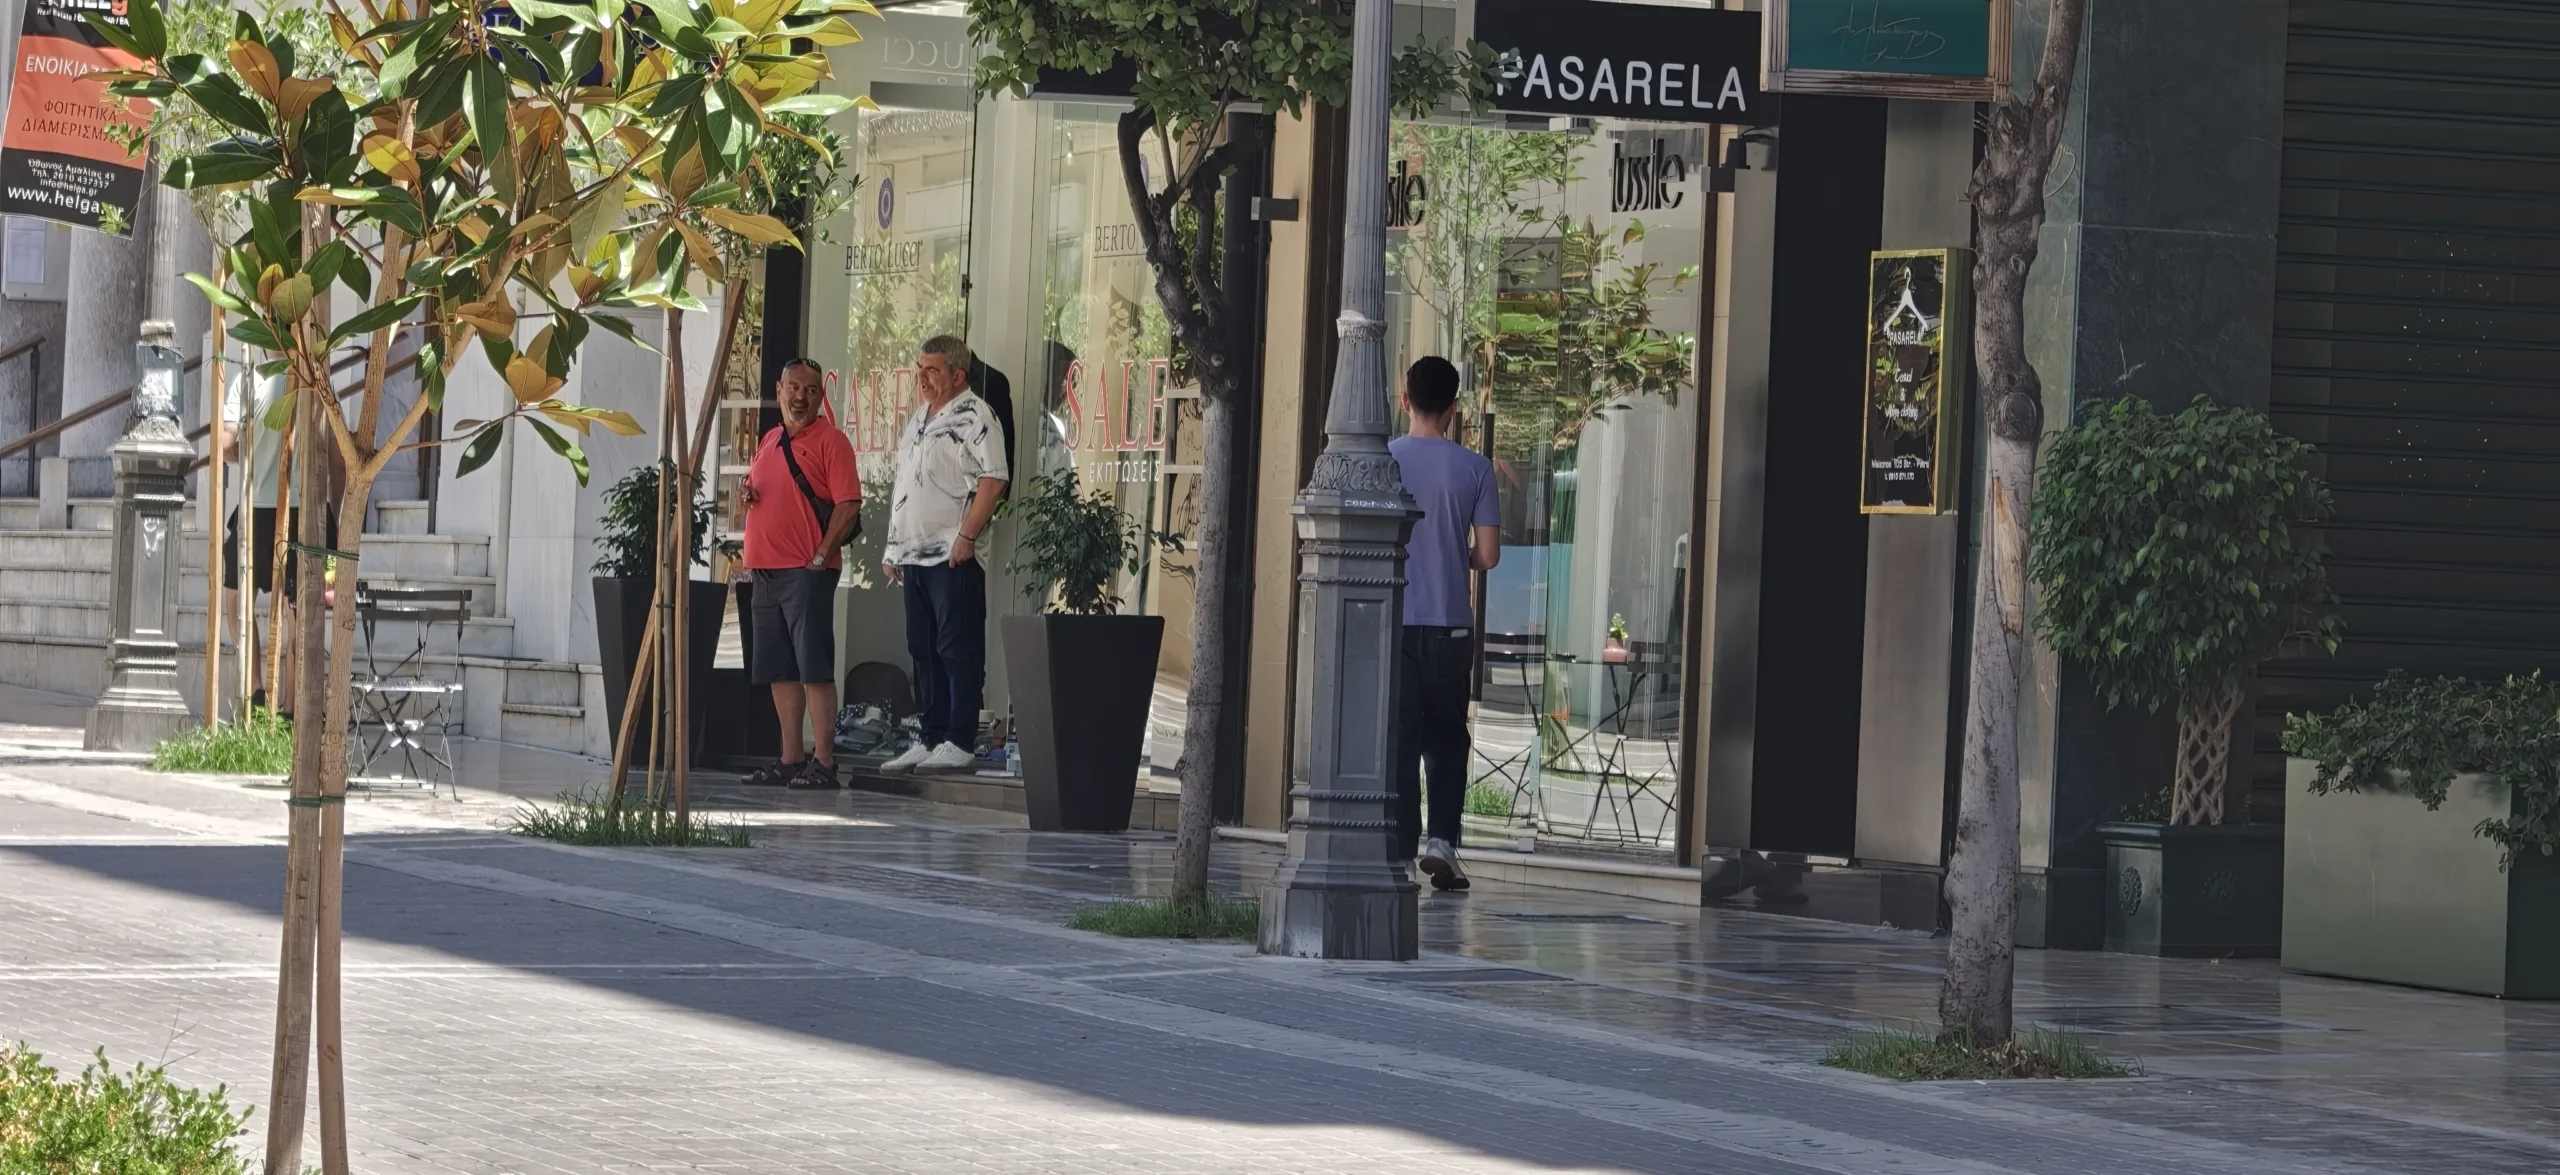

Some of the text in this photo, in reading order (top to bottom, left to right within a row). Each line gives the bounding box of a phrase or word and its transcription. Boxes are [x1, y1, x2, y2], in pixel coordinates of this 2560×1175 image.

[1496, 52, 1747, 113] PASARELA
[77, 176, 110, 189] 437357
[8, 186, 124, 222] www.helga.r
[1095, 223, 1137, 253] BERTO
[846, 243, 884, 271] BERTO
[1888, 329, 1922, 346] PASARELA
[822, 367, 927, 454] SALE
[1063, 357, 1169, 454] SALE
[1089, 460, 1161, 483] ΕΚΠΤΩΣΕΙΣ
